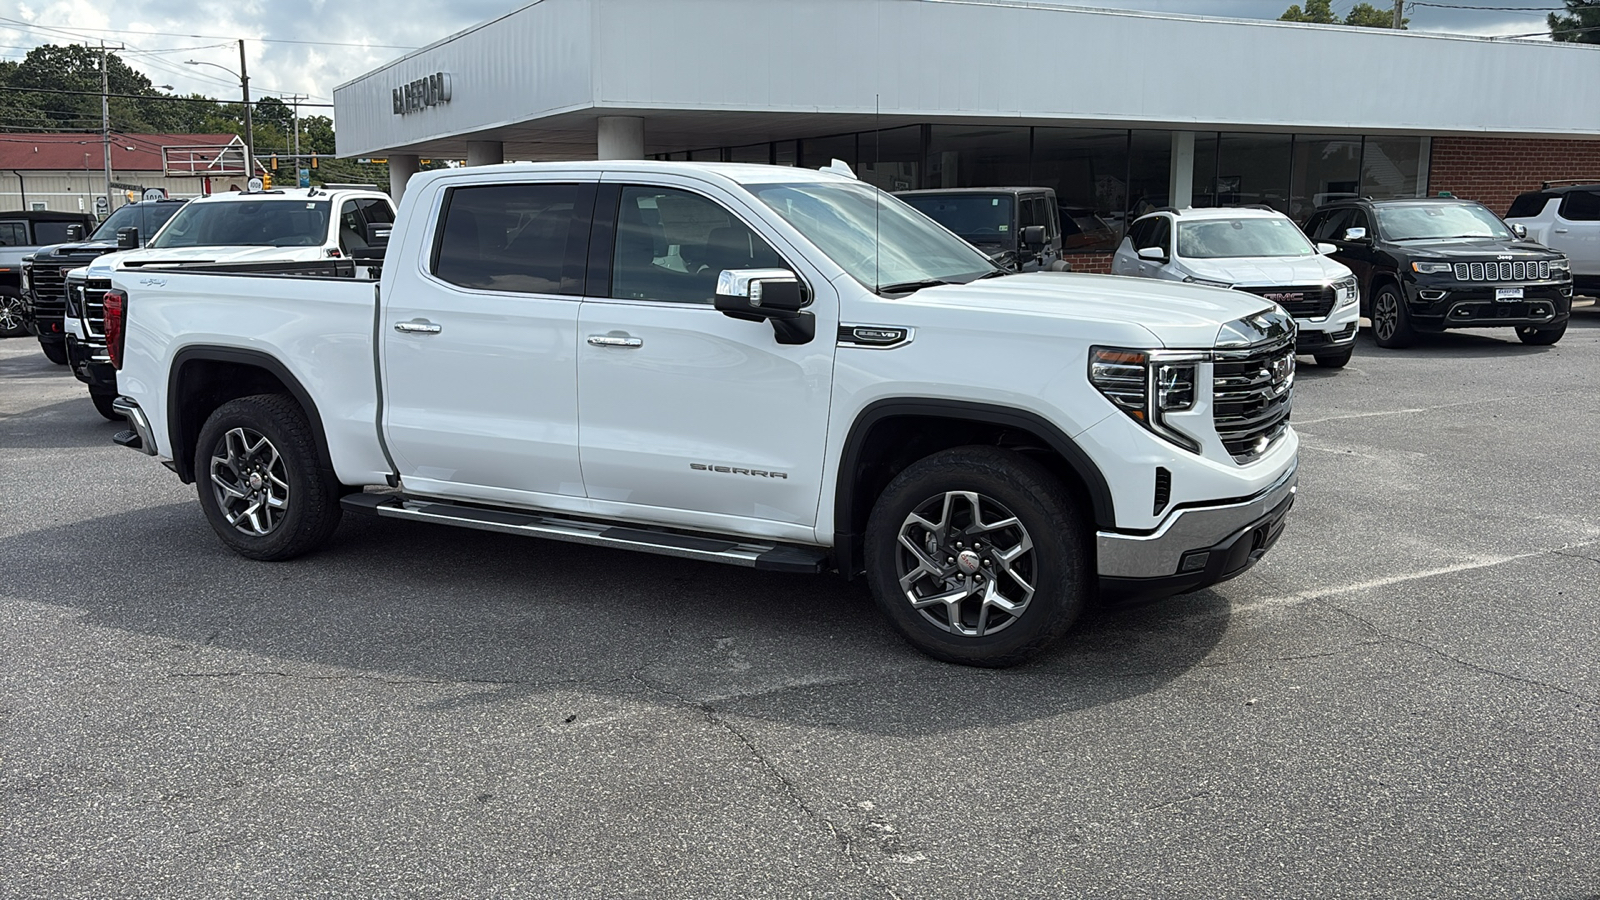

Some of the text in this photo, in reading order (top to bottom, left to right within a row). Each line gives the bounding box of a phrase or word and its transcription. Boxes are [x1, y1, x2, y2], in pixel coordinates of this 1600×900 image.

[392, 72, 452, 115] BAREFORD
[1263, 292, 1304, 301] GMC
[689, 463, 788, 479] SIERRA
